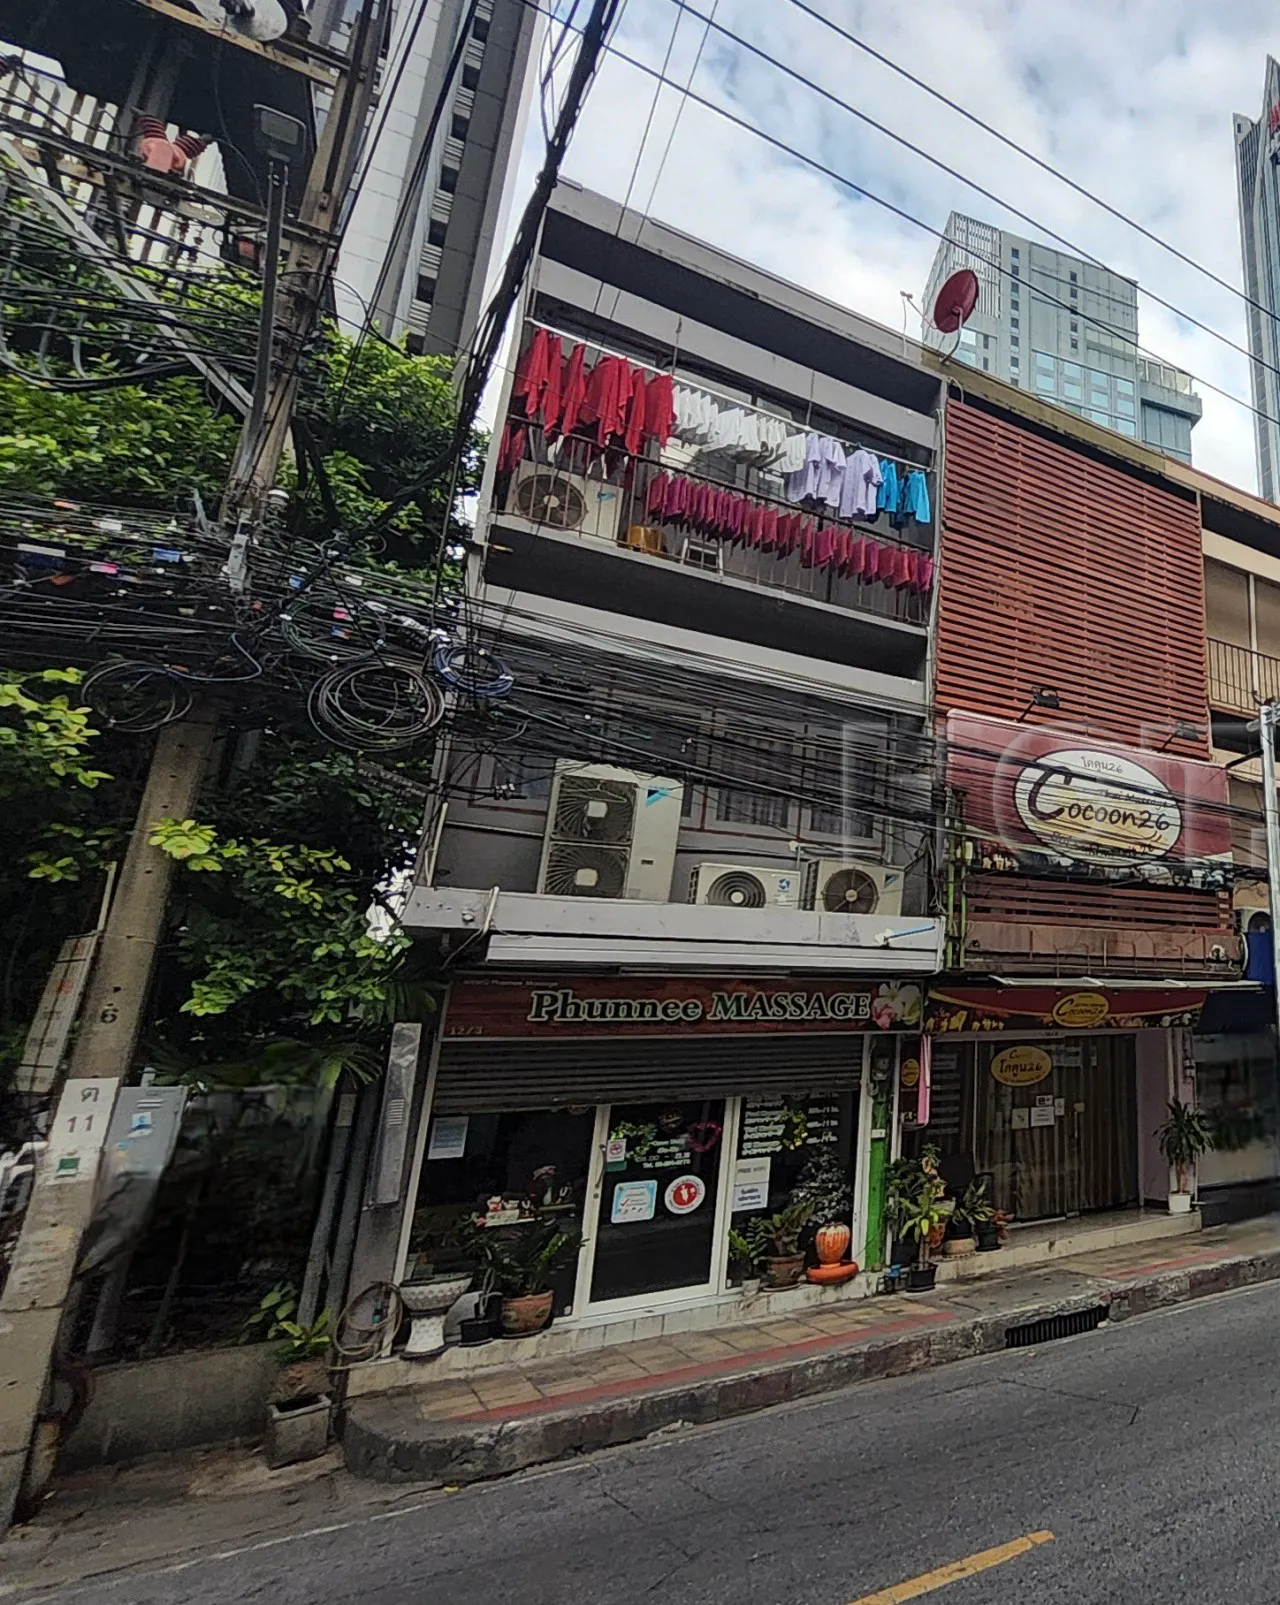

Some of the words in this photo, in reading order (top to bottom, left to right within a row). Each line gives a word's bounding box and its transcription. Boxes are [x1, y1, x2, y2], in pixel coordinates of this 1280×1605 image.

[1080, 756, 1123, 774] โคคูน26
[1028, 766, 1170, 831] Cocoon26
[527, 989, 703, 1022] Phunnee
[707, 990, 871, 1021] MASSAGE
[68, 1114, 94, 1133] 11
